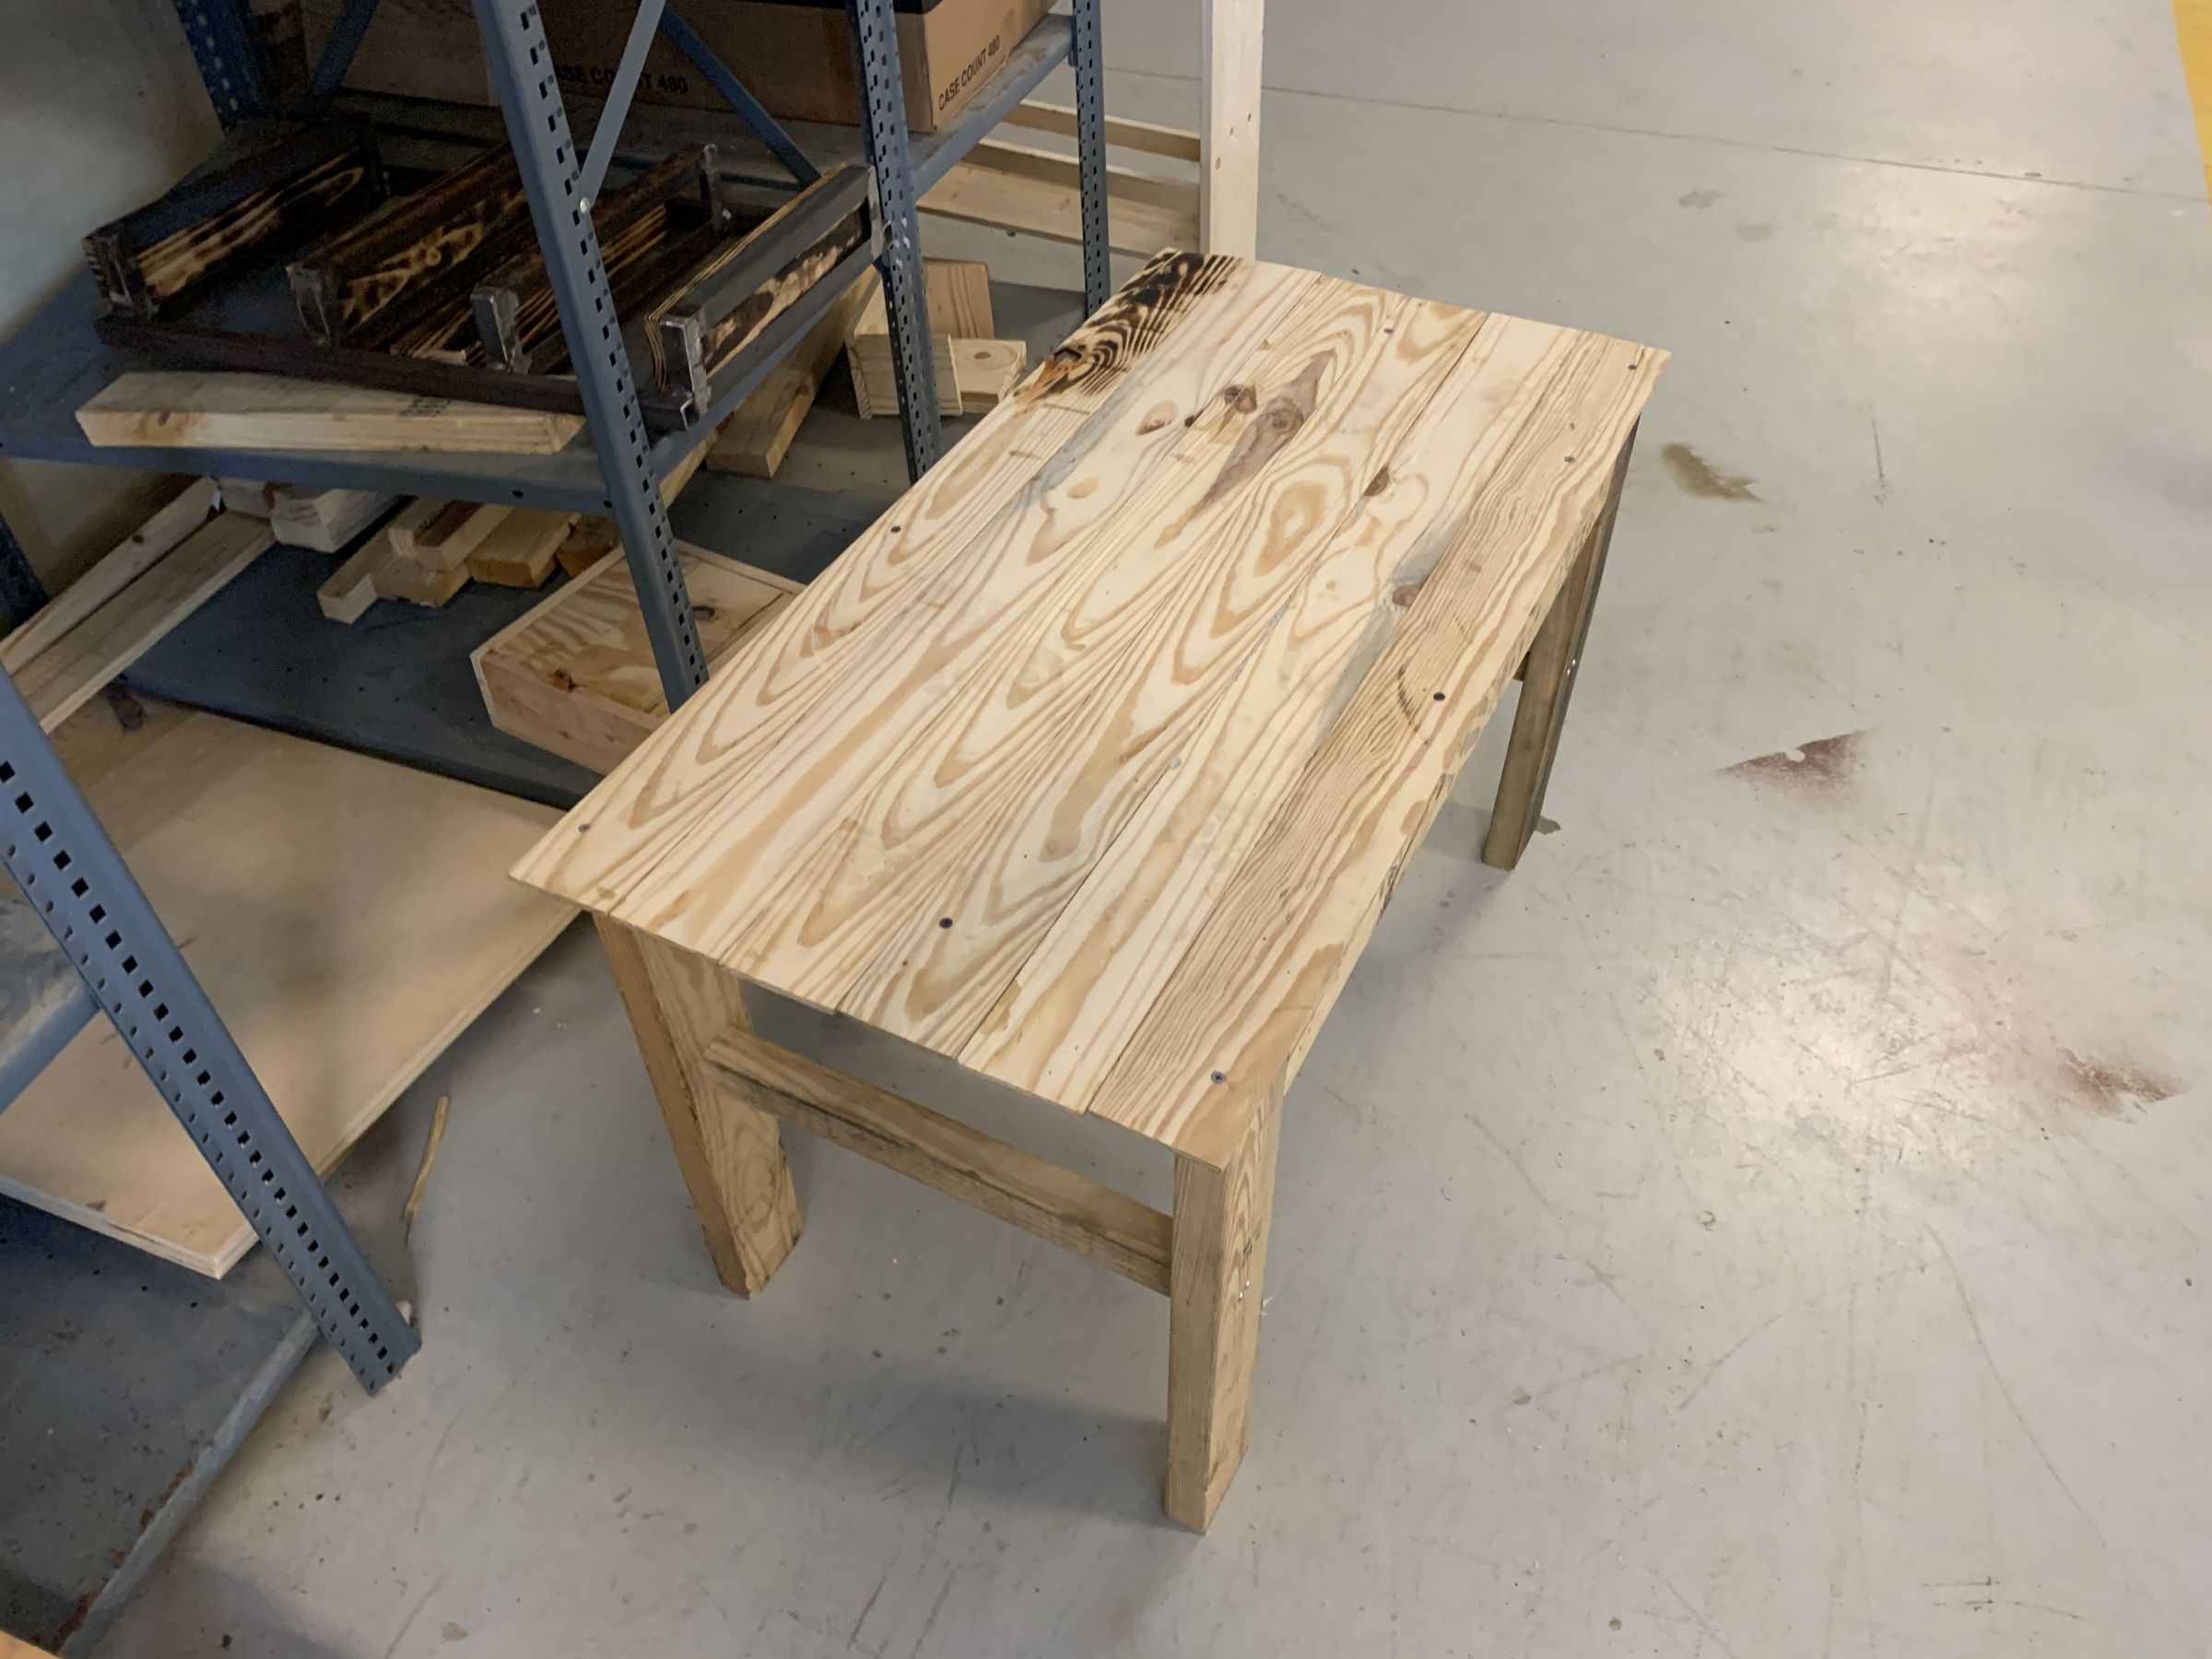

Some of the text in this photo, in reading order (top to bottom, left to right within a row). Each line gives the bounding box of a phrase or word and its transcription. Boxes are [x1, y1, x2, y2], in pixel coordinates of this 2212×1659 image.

[553, 63, 587, 83] ASE
[658, 74, 688, 94] 480
[938, 76, 960, 111] CASE
[961, 48, 987, 87] COUNT
